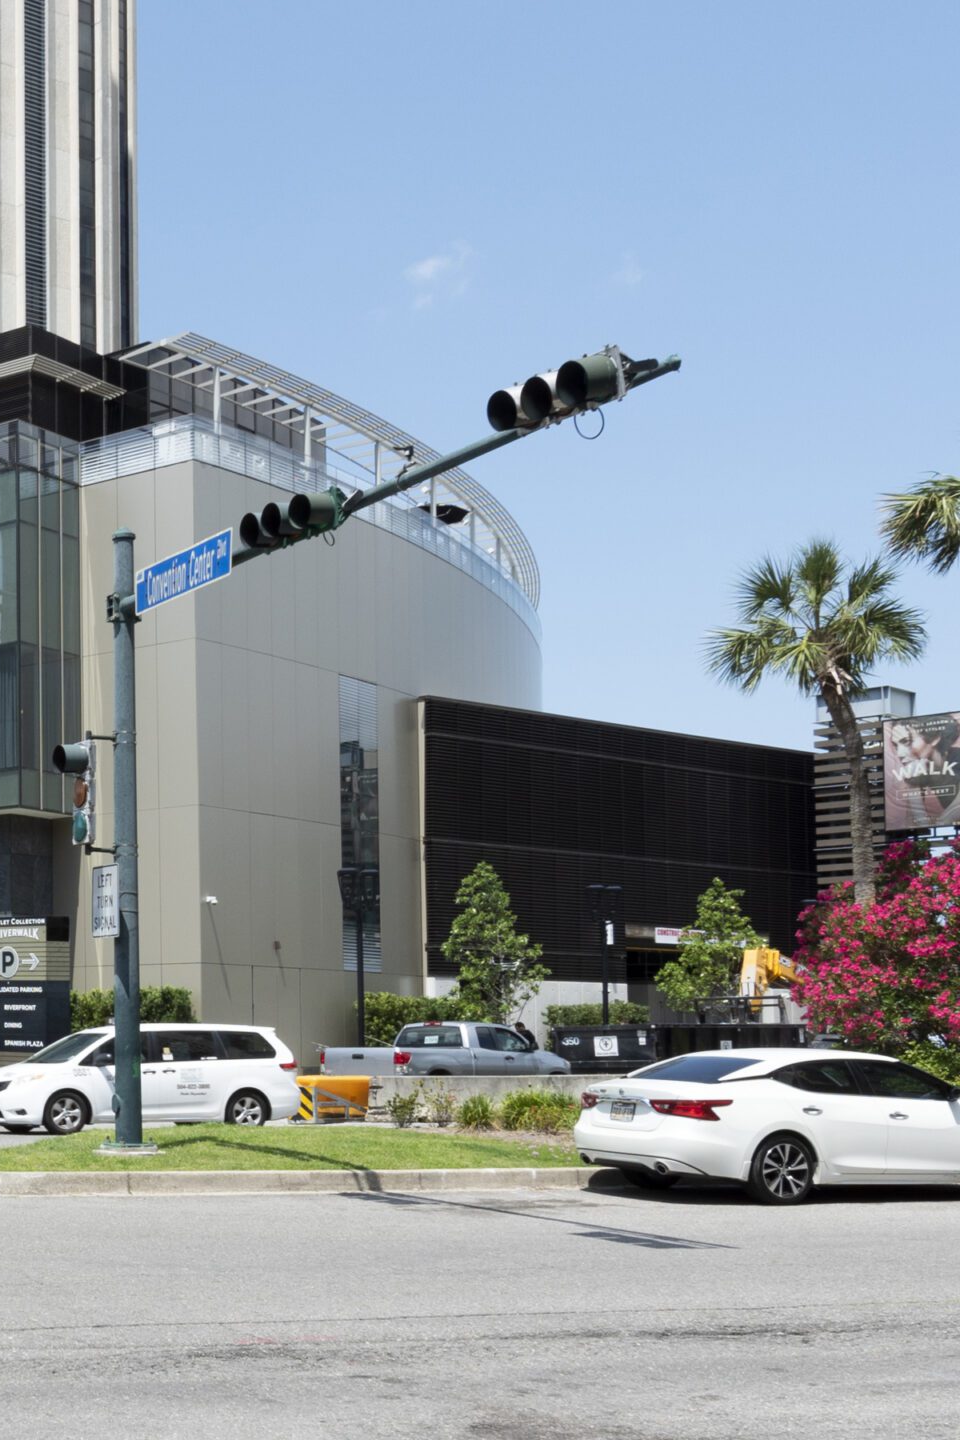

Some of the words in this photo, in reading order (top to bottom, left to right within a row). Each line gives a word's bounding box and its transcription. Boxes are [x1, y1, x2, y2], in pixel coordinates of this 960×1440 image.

[147, 558, 187, 606] Convention
[189, 545, 215, 587] Center
[892, 760, 958, 781] WALK
[97, 873, 112, 888] LEFT
[97, 895, 113, 909] TURN
[10, 917, 46, 925] COLLECTION
[94, 915, 116, 931] SIGNAL
[2, 951, 15, 973] P
[4, 1039, 26, 1047] SPANISH
